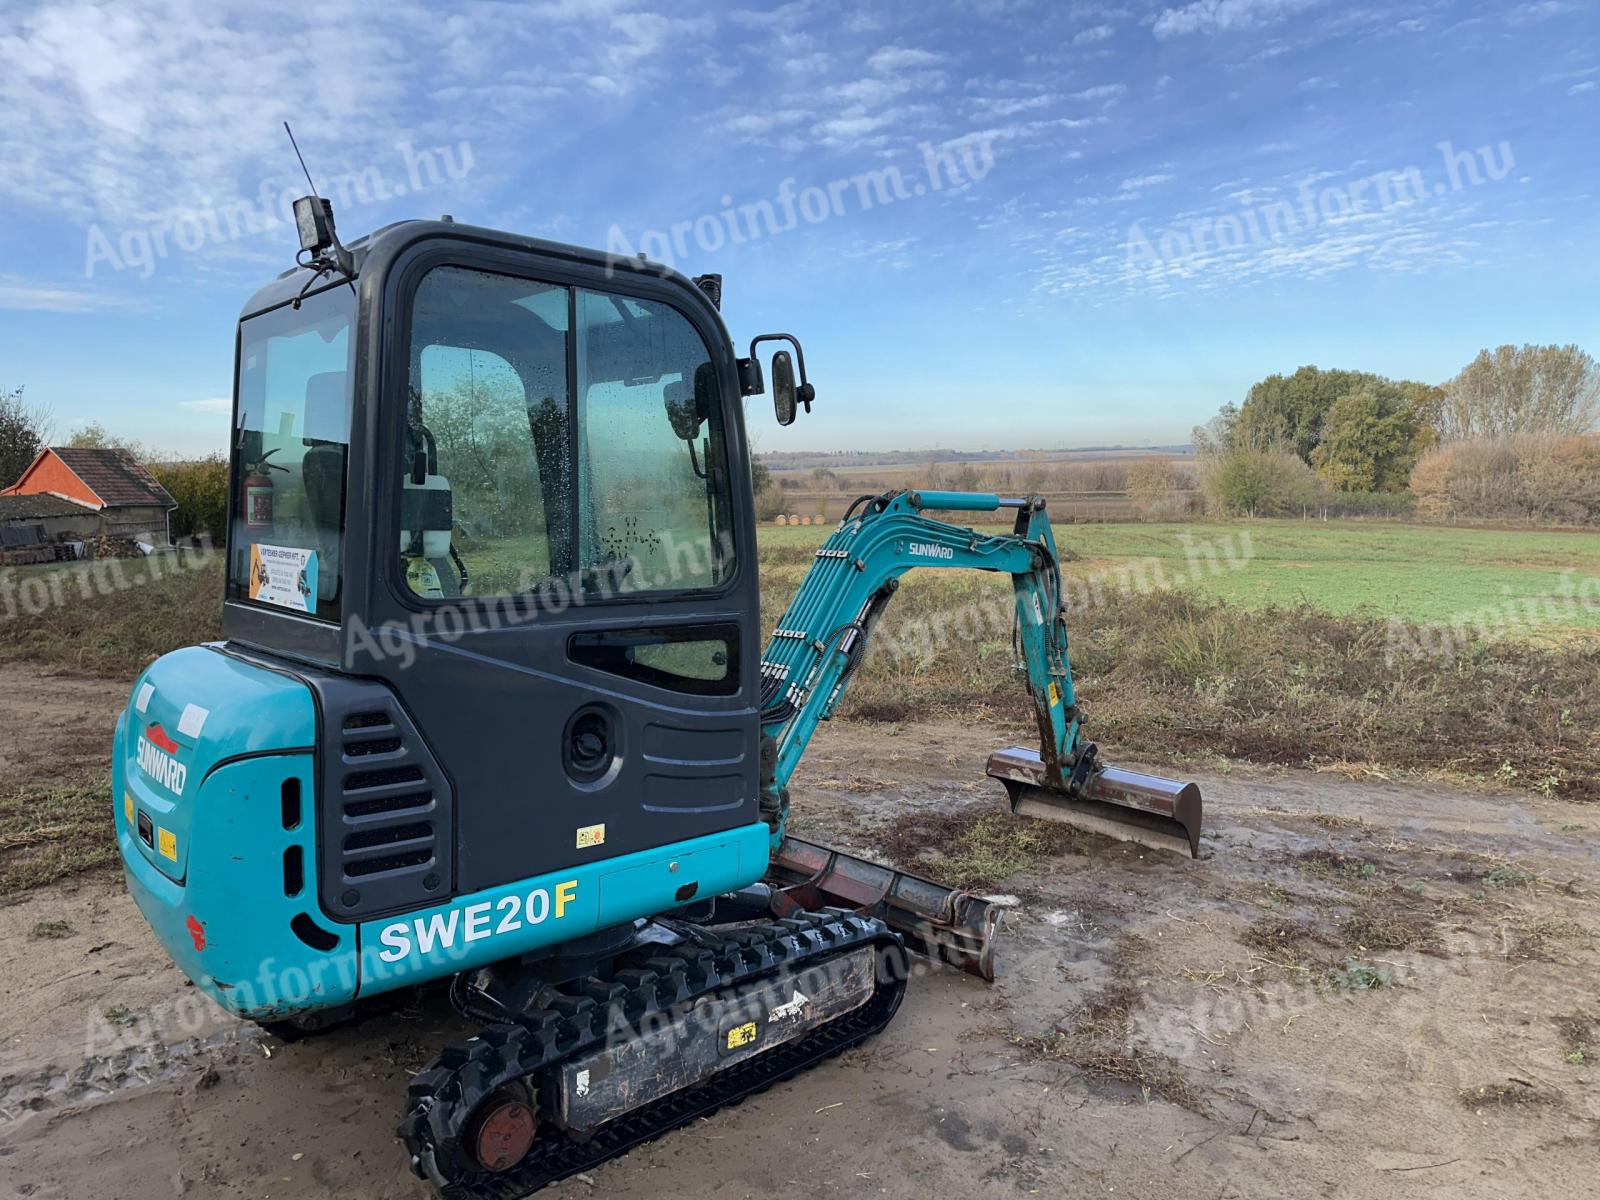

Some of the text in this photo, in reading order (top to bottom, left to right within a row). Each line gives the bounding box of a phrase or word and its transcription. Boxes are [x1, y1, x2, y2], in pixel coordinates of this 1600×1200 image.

[908, 543, 954, 560] SUNWARD
[136, 736, 187, 796] SUNWARD
[379, 879, 579, 963] SWE20F
